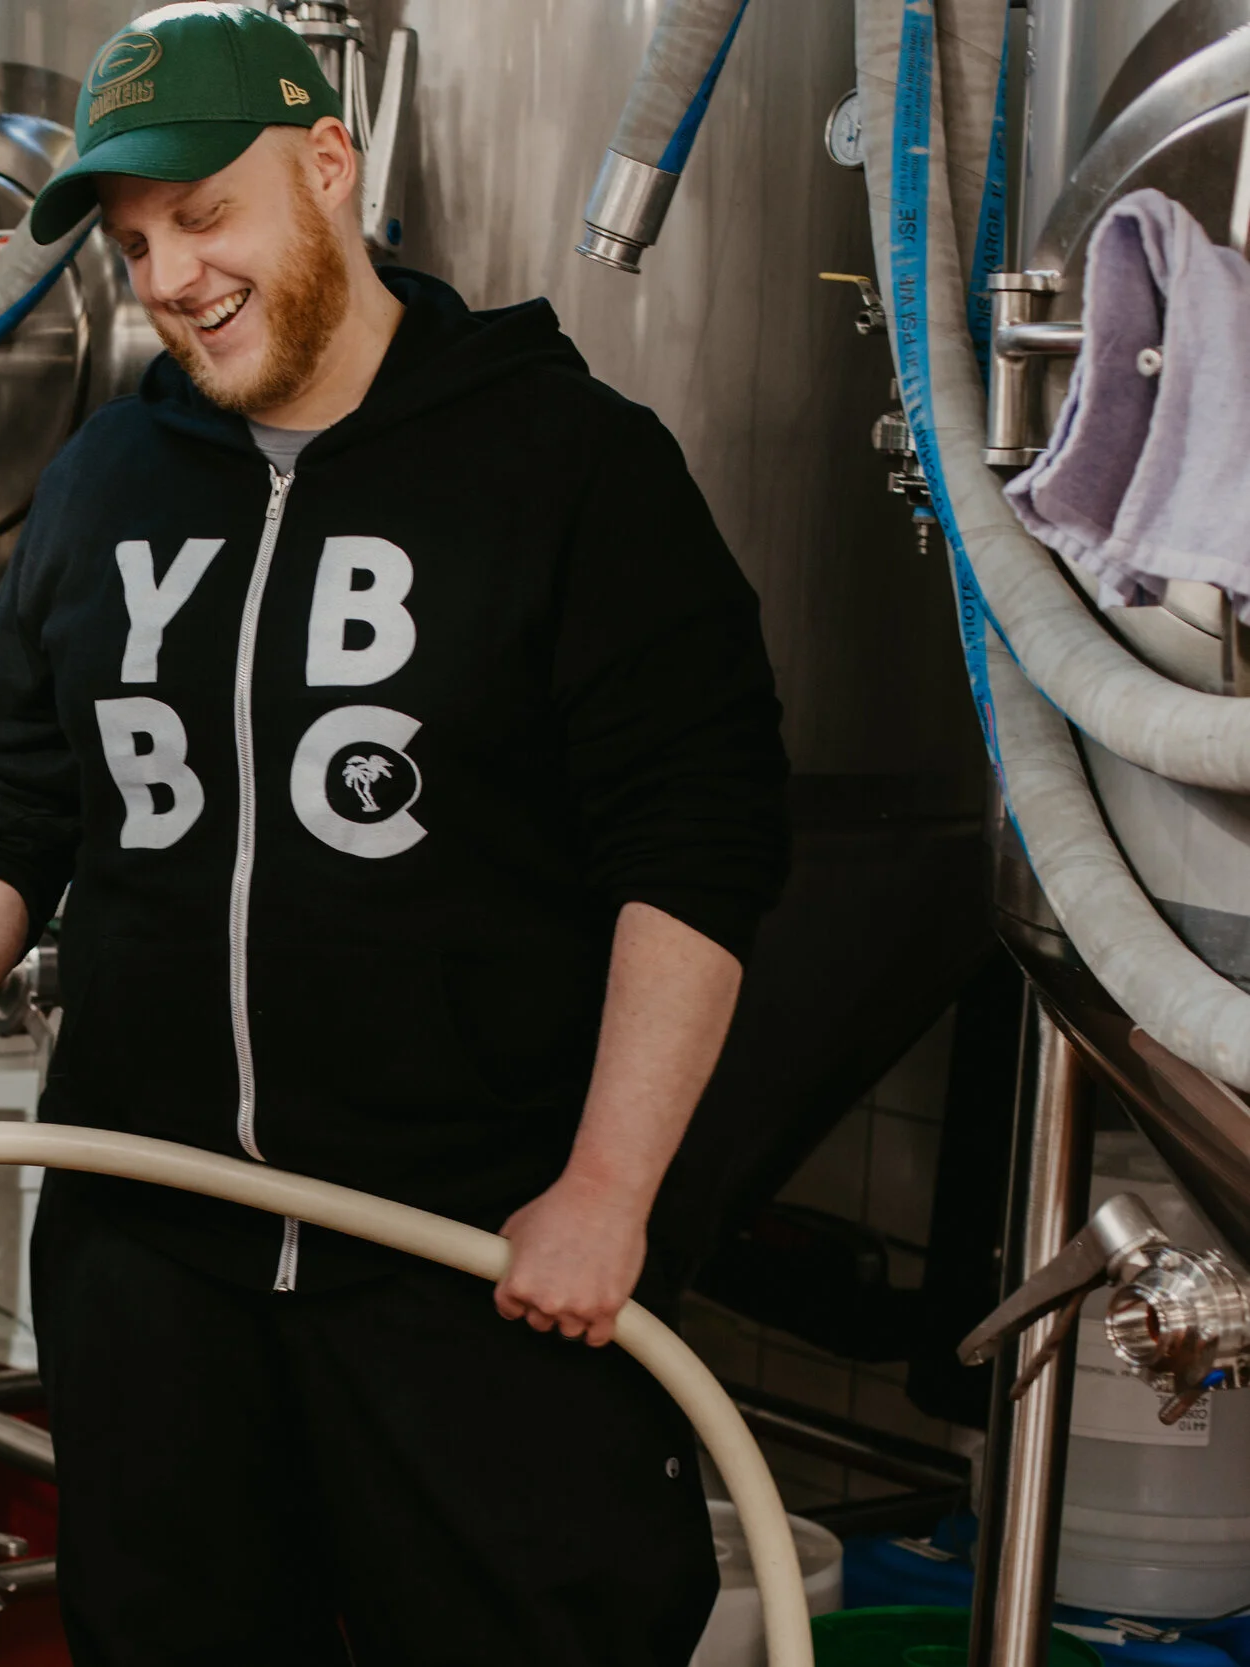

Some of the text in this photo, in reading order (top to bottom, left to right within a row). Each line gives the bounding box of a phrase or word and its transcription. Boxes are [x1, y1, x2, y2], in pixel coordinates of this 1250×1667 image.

[899, 312, 917, 344] PSI
[975, 208, 1001, 331] DISHARGE
[115, 535, 417, 687] Y B
[94, 696, 428, 859] B C
